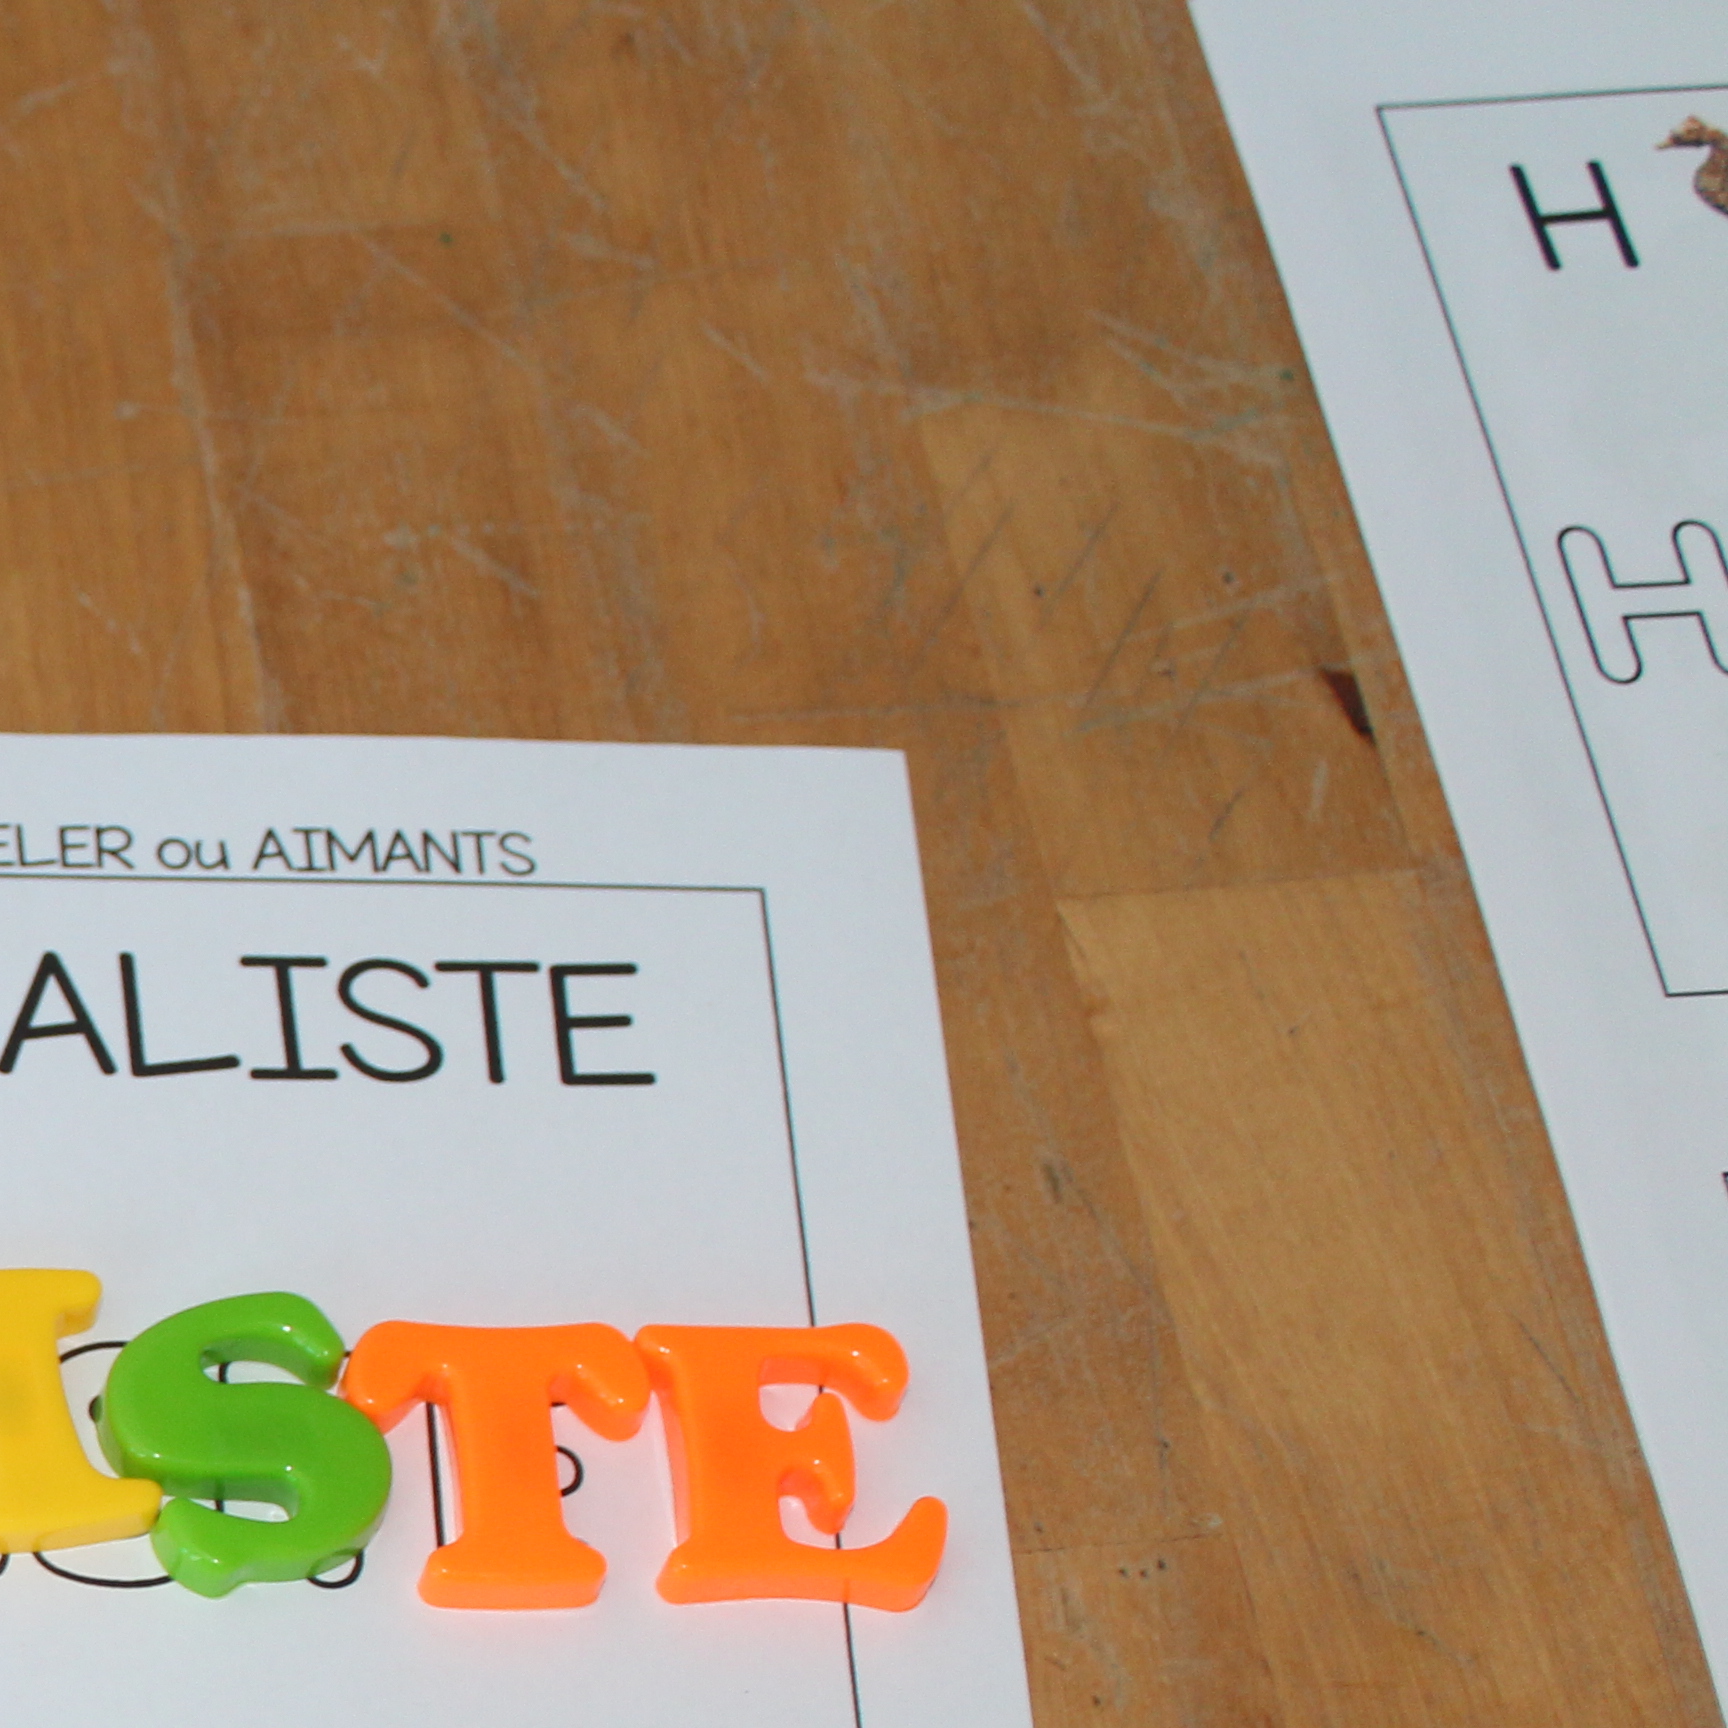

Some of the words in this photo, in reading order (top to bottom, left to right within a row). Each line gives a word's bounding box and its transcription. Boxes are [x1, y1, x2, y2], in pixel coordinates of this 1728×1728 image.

[1509, 160, 1640, 272] H
[156, 837, 234, 872] ou
[251, 827, 538, 878] AIMANTS
